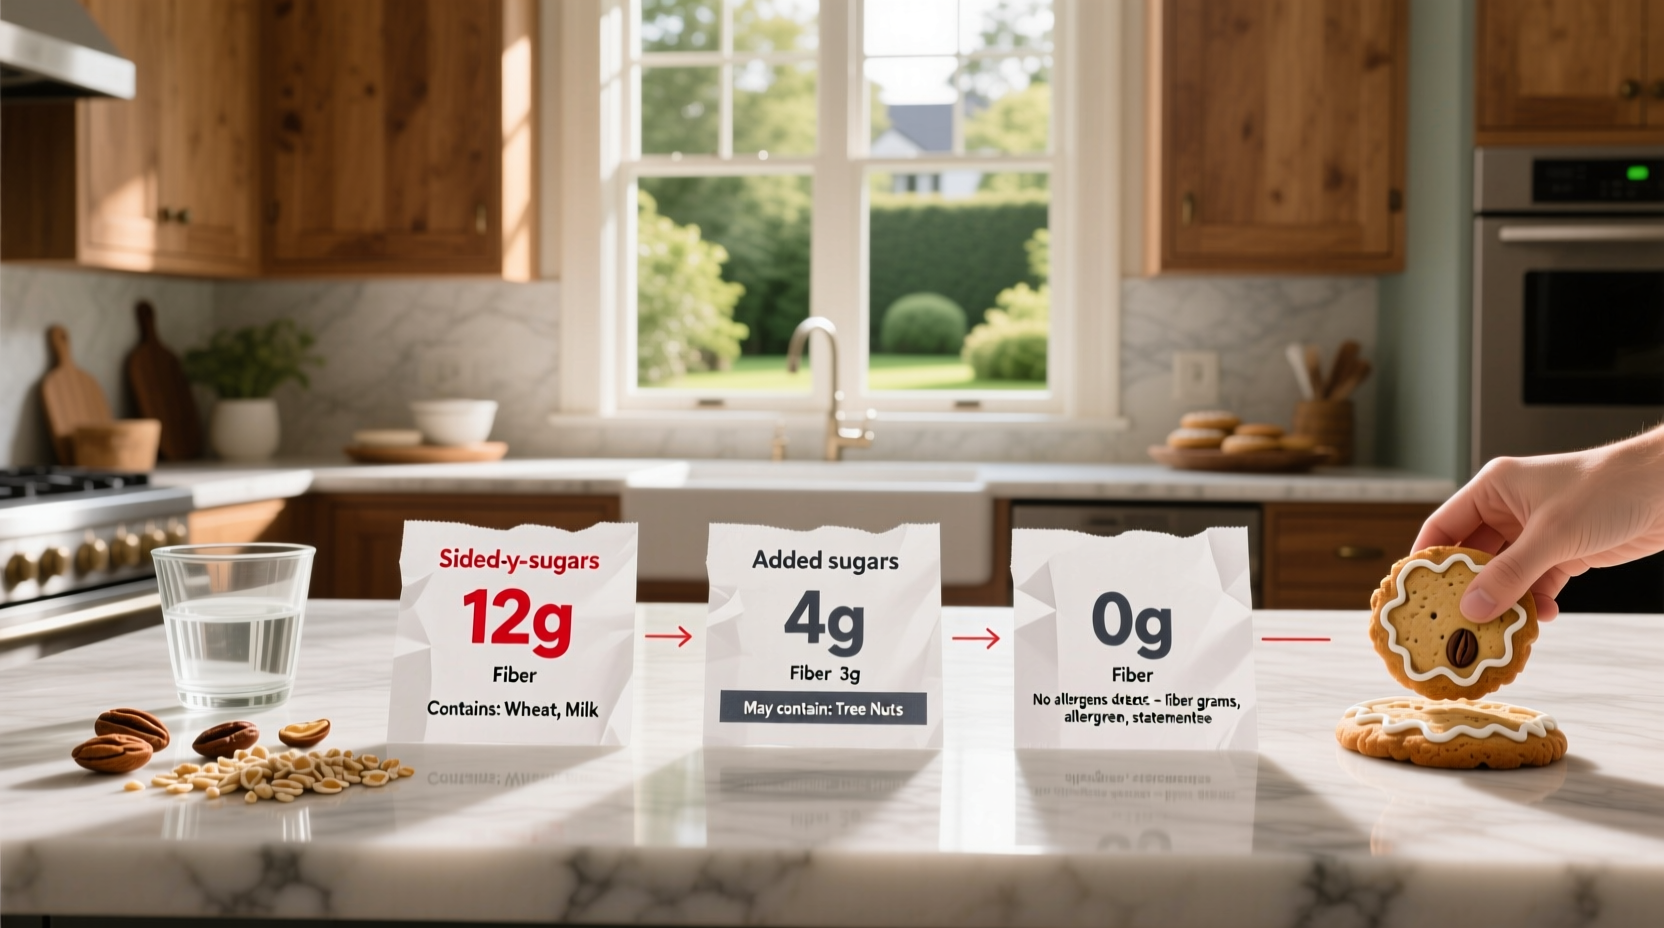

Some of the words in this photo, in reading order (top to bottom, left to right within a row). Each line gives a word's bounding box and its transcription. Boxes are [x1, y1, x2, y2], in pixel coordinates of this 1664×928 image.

[440, 548, 600, 575] Sided-y-sugars
[752, 550, 823, 570] Added
[829, 555, 899, 575] sugars
[463, 588, 573, 659] 12g
[784, 590, 864, 658] 4g
[1092, 591, 1172, 660] 0g
[492, 666, 538, 683] Fiber
[790, 665, 832, 681] Fiber
[840, 666, 861, 685] 3g
[1112, 667, 1154, 682] Fiber
[427, 700, 501, 717] Contains:
[504, 701, 561, 721] Wheat,
[565, 701, 599, 718] Milk
[743, 700, 774, 718] May
[777, 701, 833, 716] contain:
[836, 702, 867, 716] Tree
[870, 702, 904, 717] Nuts
[1033, 693, 1051, 706] No
[1054, 693, 1108, 709] allergens
[1197, 697, 1241, 711] grams,
